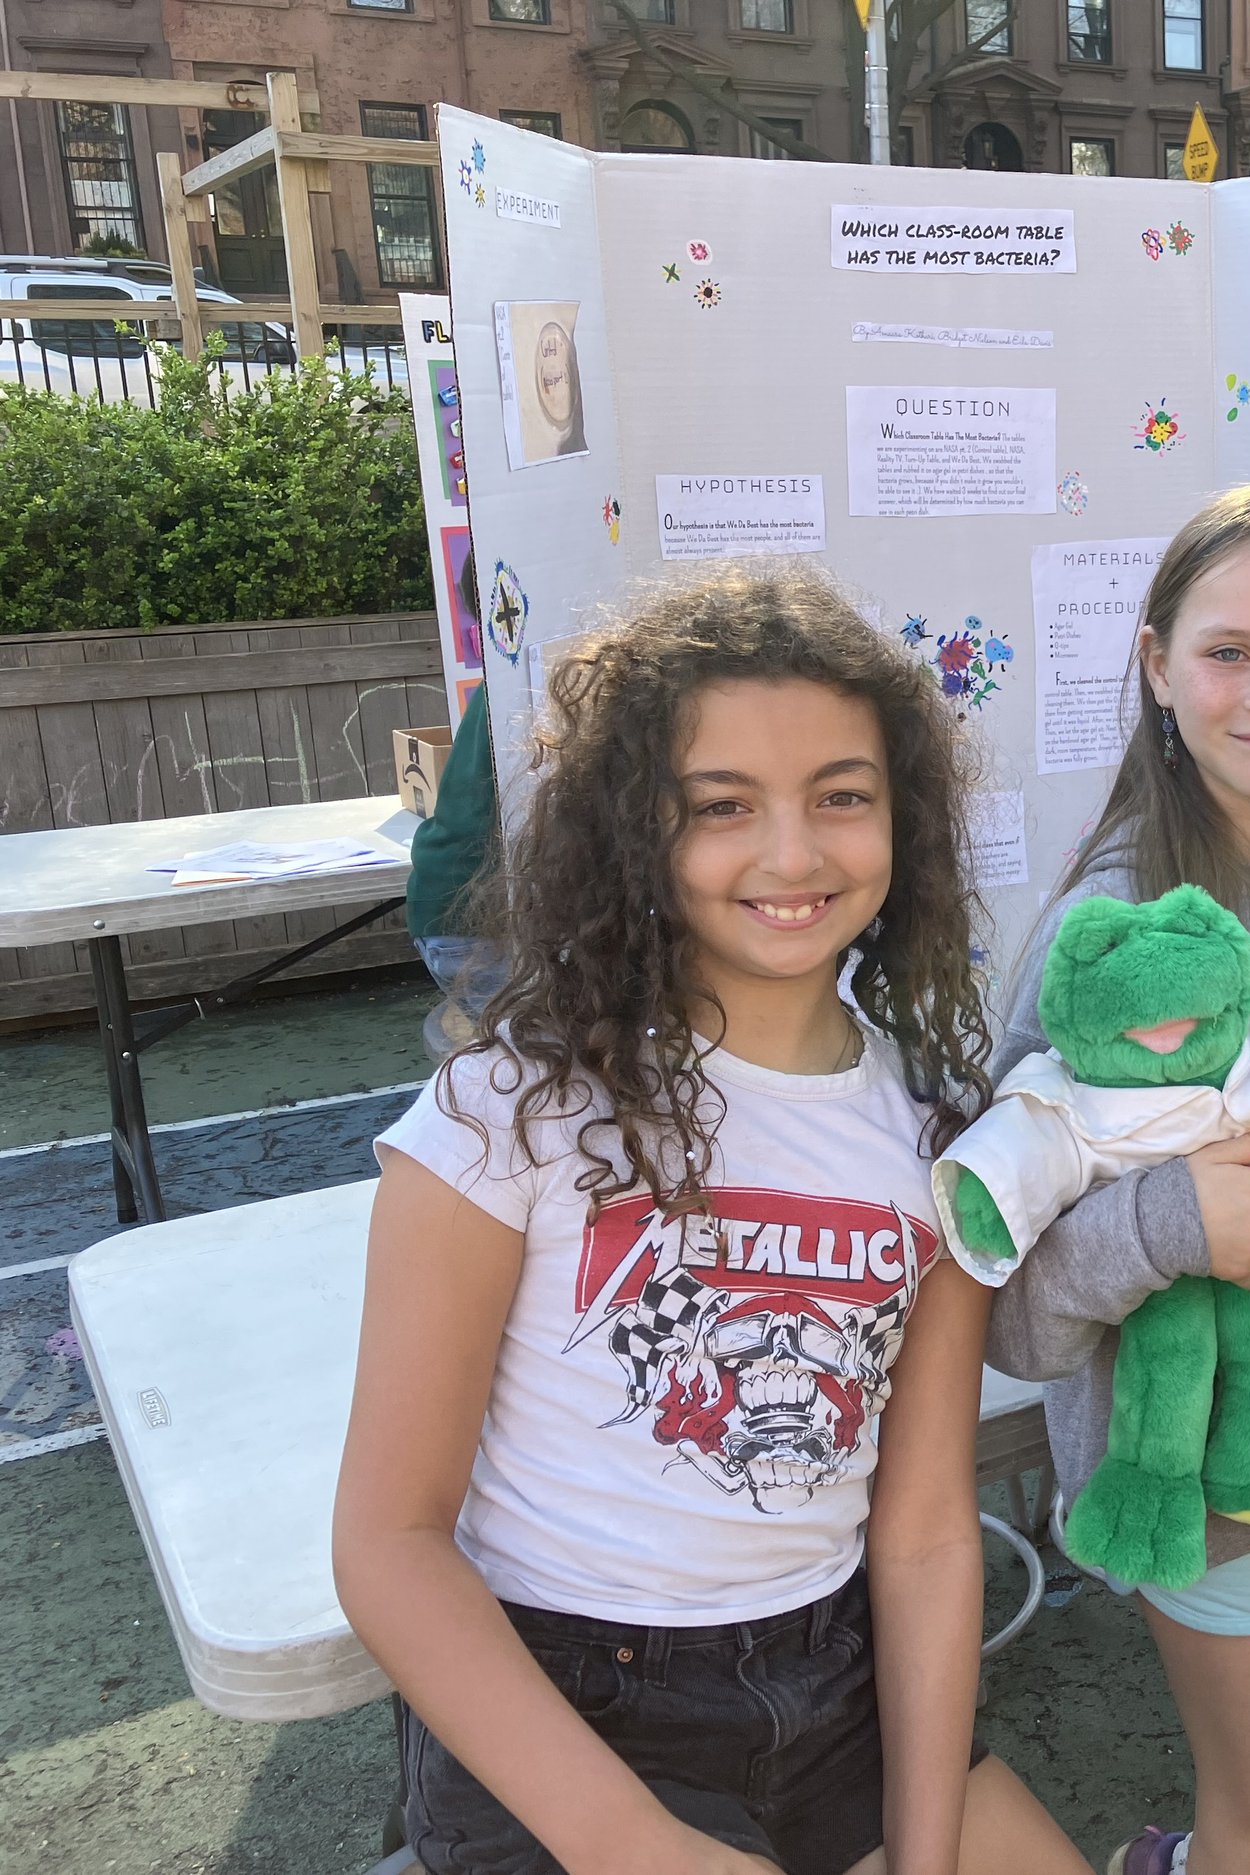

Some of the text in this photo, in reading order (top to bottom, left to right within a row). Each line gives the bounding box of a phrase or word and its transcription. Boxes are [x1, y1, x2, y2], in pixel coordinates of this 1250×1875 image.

[496, 192, 560, 222] EXPERIMENT
[905, 223, 1009, 240] CLASS-ROOM
[1016, 225, 1064, 240] TABLE
[847, 249, 1061, 266] HAS THE MOST BACTERIA?
[421, 320, 453, 343] FL
[896, 398, 1010, 417] QUESTION
[881, 423, 904, 439] Which
[905, 431, 930, 440] Classroom
[931, 431, 944, 440] Table
[945, 431, 954, 440] Has
[955, 431, 964, 440] The
[965, 432, 977, 440] Most
[978, 432, 1001, 441] Bacteria?
[681, 480, 811, 493] HYPOTHESIS
[664, 513, 679, 530] Our
[1064, 552, 1166, 566] MATERIALS
[561, 1180, 919, 1355] METALLICA
